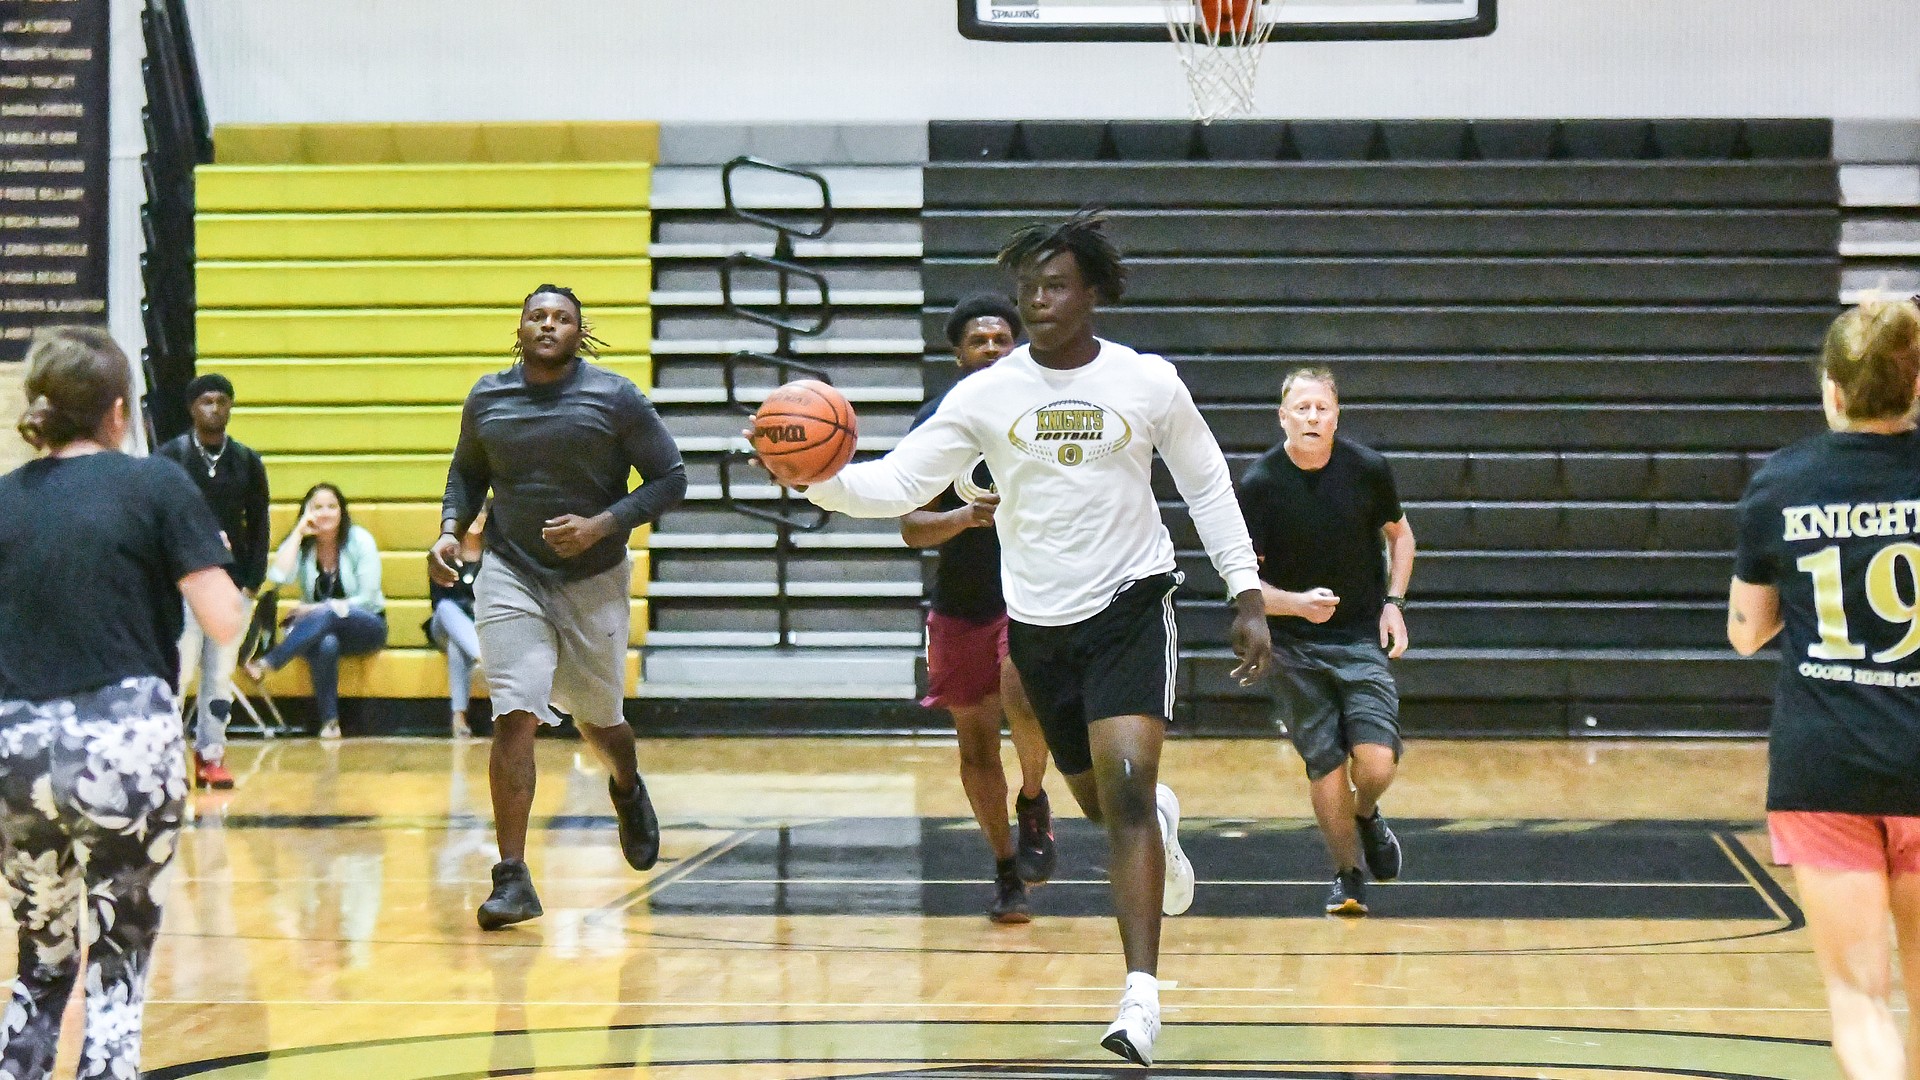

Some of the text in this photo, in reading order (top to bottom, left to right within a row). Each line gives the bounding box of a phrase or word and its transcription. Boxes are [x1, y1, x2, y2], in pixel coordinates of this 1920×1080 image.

[991, 9, 1040, 20] SPALDING
[1036, 410, 1104, 431] KNIGHTS
[755, 425, 808, 444] Wilso
[1035, 432, 1102, 441] FOOTBALL
[1796, 542, 1920, 663] 19
